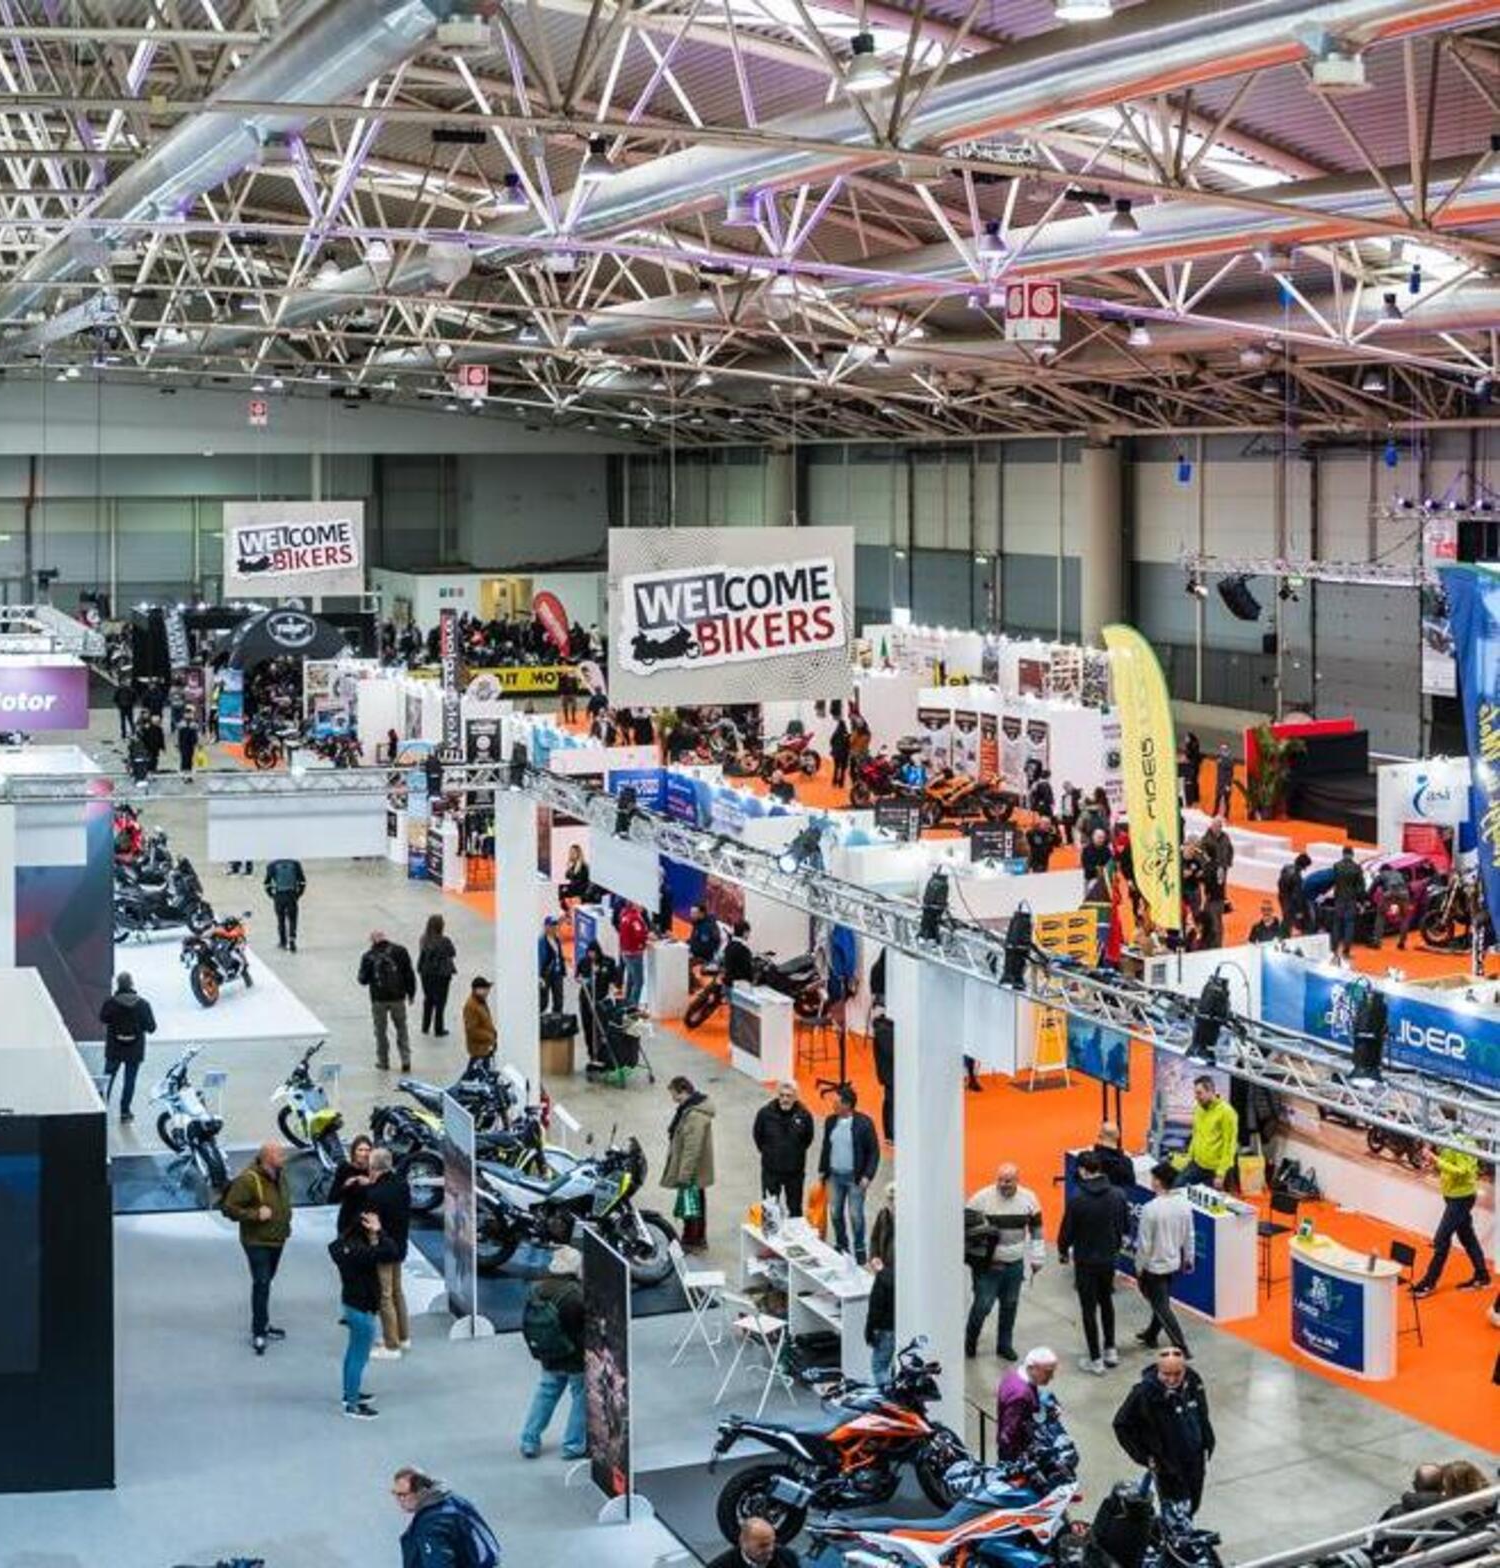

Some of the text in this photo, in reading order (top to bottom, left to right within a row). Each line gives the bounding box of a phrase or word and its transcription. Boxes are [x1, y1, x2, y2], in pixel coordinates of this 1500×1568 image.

[241, 523, 350, 555] WELCOME
[273, 544, 352, 570] BIKERS
[637, 566, 830, 625] WELCOME
[697, 605, 835, 657] BIKERS
